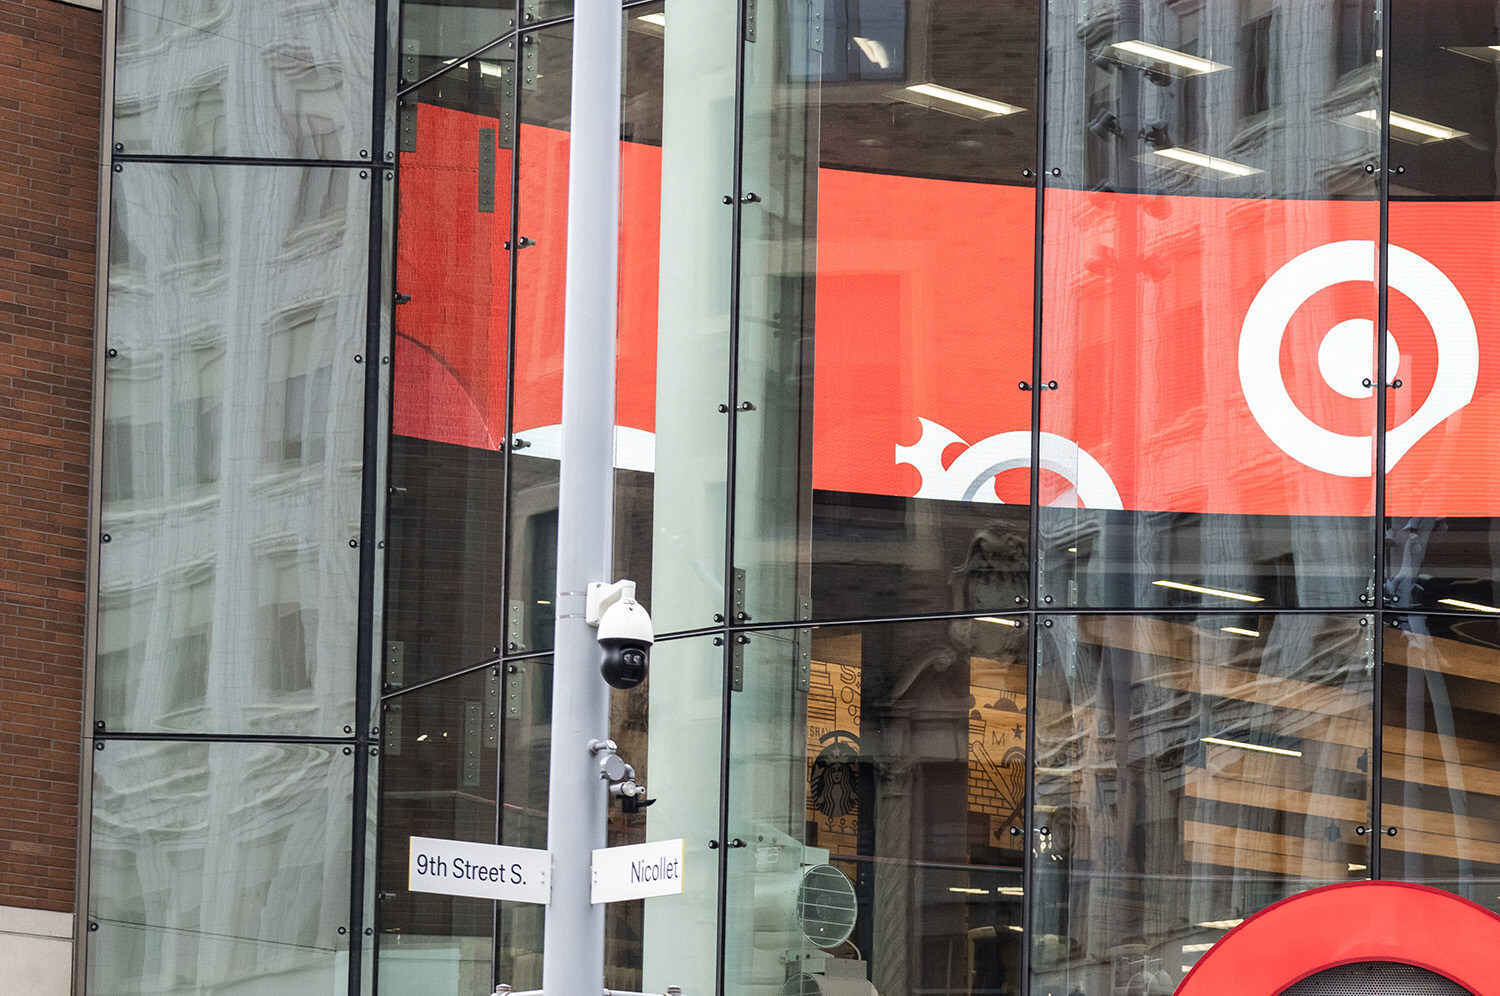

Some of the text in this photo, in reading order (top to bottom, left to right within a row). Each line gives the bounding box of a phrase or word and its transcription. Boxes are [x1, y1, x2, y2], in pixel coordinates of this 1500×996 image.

[416, 853, 527, 886] 9th Street S.
[630, 857, 679, 884] Nicollet
